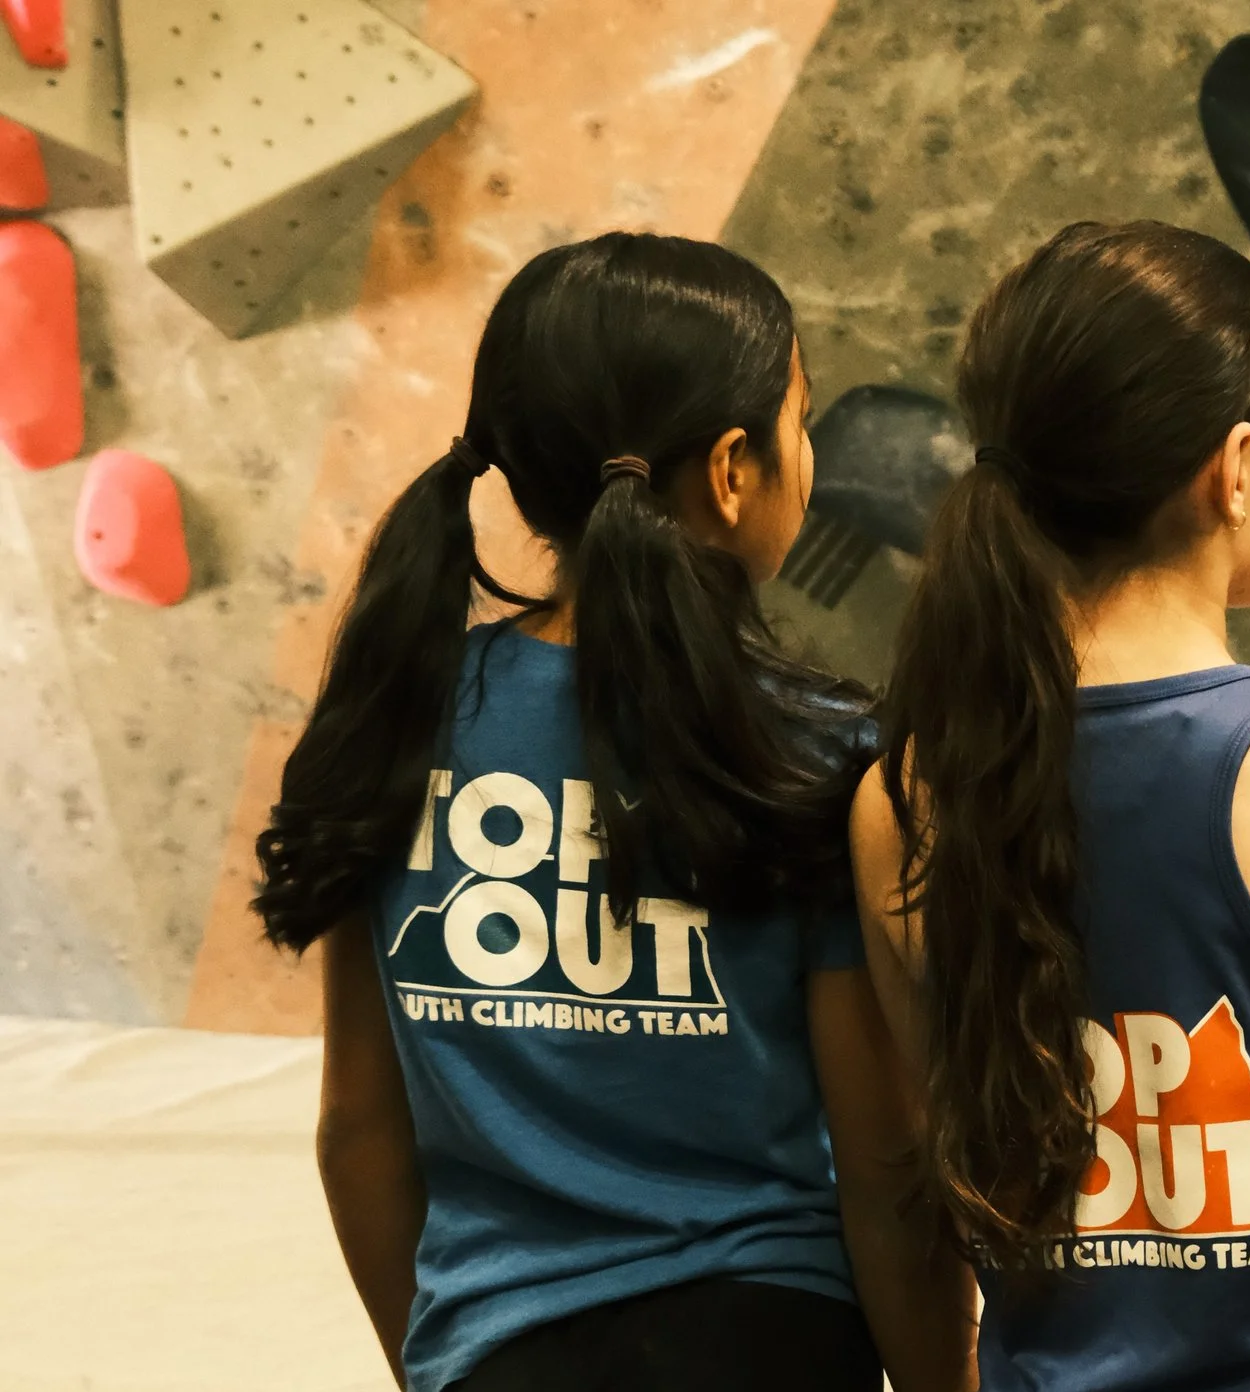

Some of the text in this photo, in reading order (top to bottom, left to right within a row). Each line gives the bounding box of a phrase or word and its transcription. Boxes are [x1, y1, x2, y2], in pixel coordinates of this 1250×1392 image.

[444, 881, 709, 996] OUT
[397, 992, 728, 1036] UTH CLIMBING TEAM
[1072, 1239, 1206, 1270] CLIMBING
